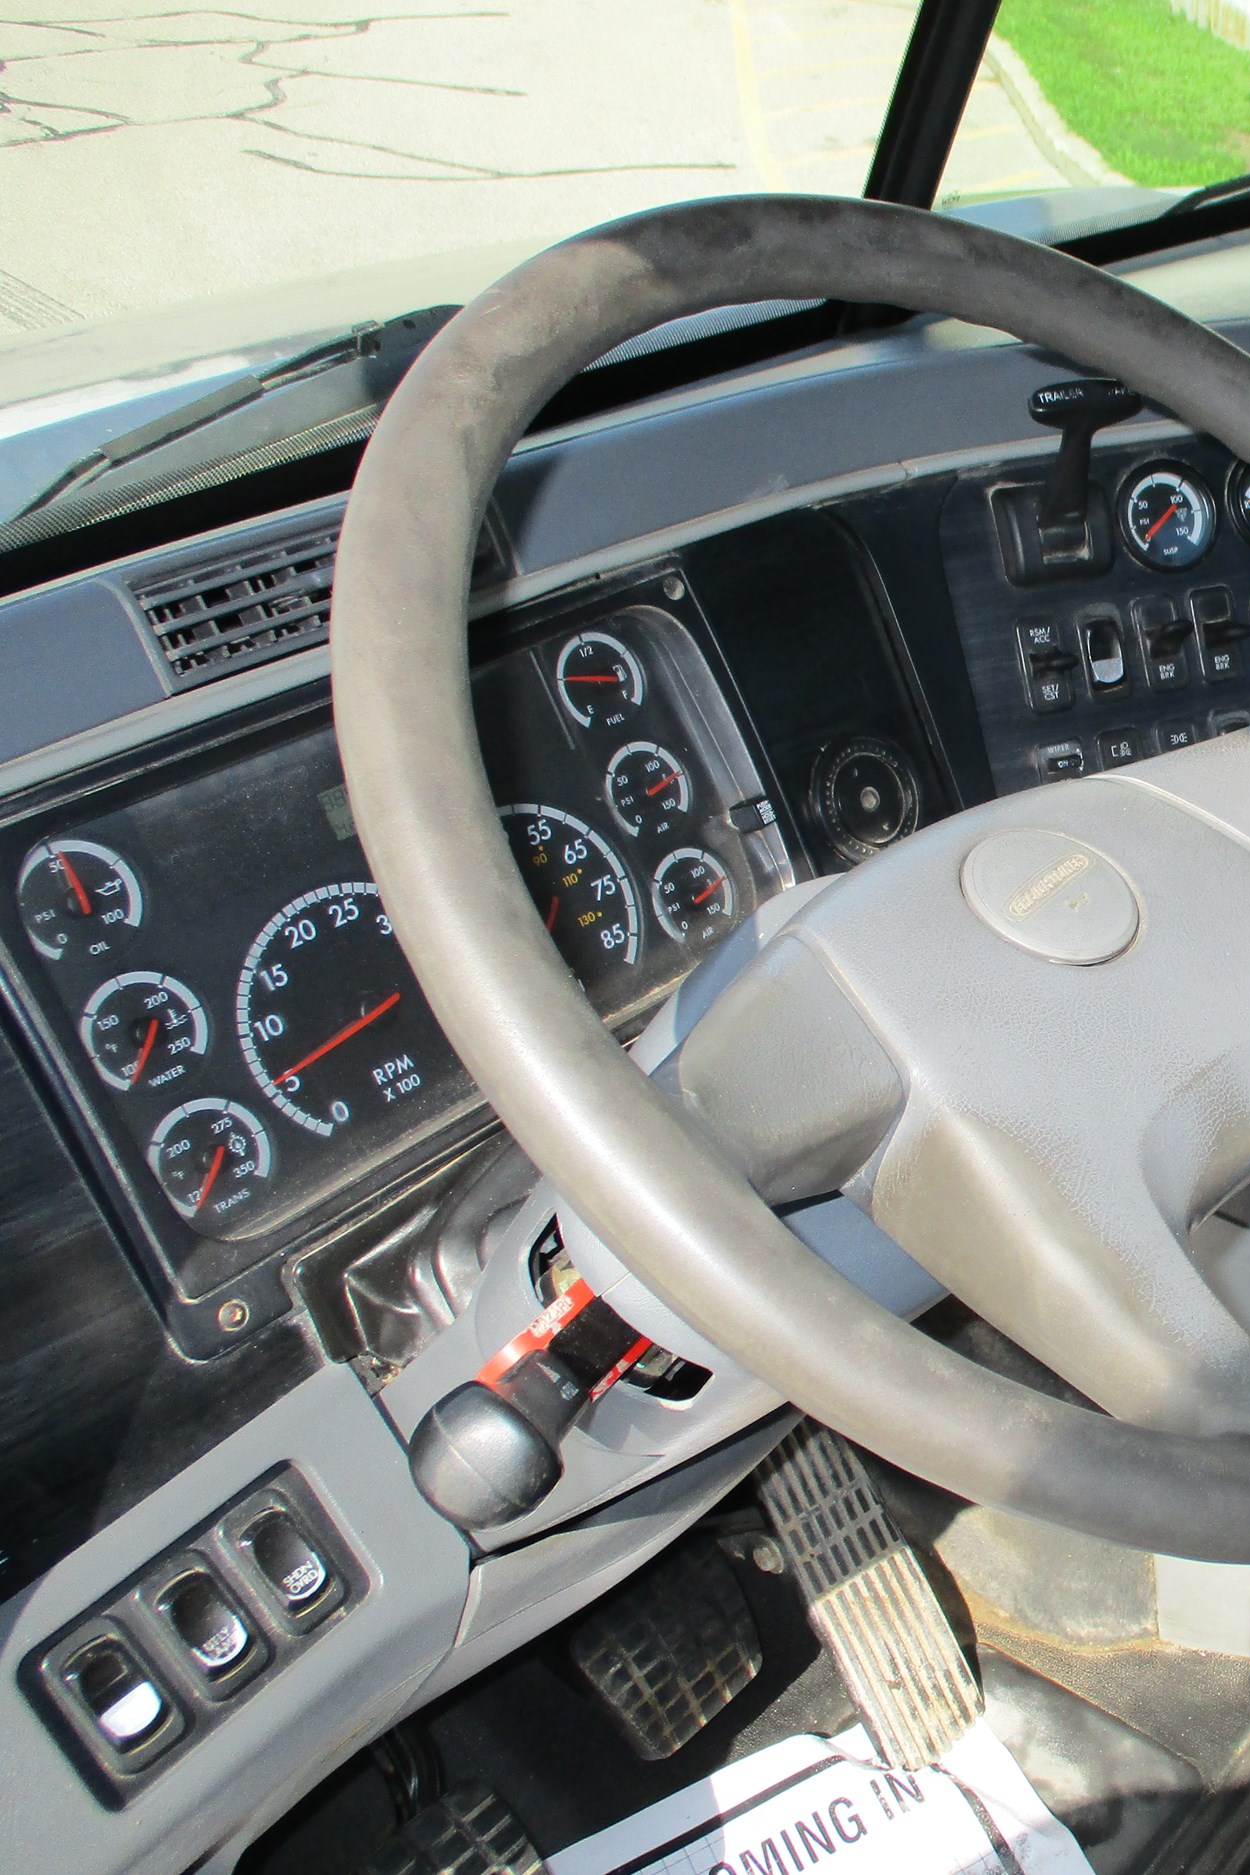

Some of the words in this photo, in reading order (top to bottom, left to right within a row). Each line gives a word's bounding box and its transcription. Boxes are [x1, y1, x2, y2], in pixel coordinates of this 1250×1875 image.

[1138, 501, 1148, 510] 50
[1170, 495, 1183, 504] 100
[1176, 527, 1189, 536] 150
[1034, 634, 1051, 644] ACC
[579, 646, 593, 658] 1/2
[621, 690, 628, 699] F
[587, 705, 594, 714] E
[606, 713, 625, 726] FUEL
[645, 760, 660, 773] 100
[617, 775, 628, 787] 50
[621, 796, 634, 807] PSI
[662, 798, 676, 811] 150
[635, 815, 642, 824] 0
[527, 819, 552, 846] 55
[657, 822, 670, 834] AIR
[564, 839, 588, 865] 65
[533, 854, 547, 866] 90
[690, 866, 705, 878] 100
[563, 873, 578, 888] 110
[590, 874, 616, 902] 75
[664, 882, 675, 894] 50
[328, 898, 360, 929] 25
[668, 903, 680, 913] PSI
[707, 903, 720, 915] 150
[34, 909, 56, 923] PSI
[101, 909, 124, 924] 100
[577, 912, 596, 927] 130
[376, 914, 393, 935] 3
[681, 921, 688, 930] 0
[56, 933, 68, 944] 0
[285, 919, 317, 950] 20
[601, 923, 625, 950] 85
[702, 927, 715, 939] AIR
[89, 941, 111, 955] OIL
[259, 964, 289, 992] 15
[144, 991, 168, 1009] 200
[96, 1015, 119, 1031] 150
[254, 1014, 284, 1042] 10
[168, 1037, 190, 1055] 250
[121, 1060, 138, 1076] 10
[372, 1054, 415, 1085] RPM
[148, 1065, 186, 1087] WATER
[383, 1087, 397, 1102] X
[397, 1074, 421, 1094] 100
[331, 1100, 350, 1123] 0
[211, 1117, 232, 1135] 275
[166, 1139, 191, 1159] 200
[233, 1160, 255, 1178] 350
[213, 1188, 251, 1213] TRANS
[283, 1560, 313, 1587] SHDN
[290, 1569, 318, 1593] OVRD
[708, 1797, 868, 1875] MING
[869, 1773, 926, 1821] IN
